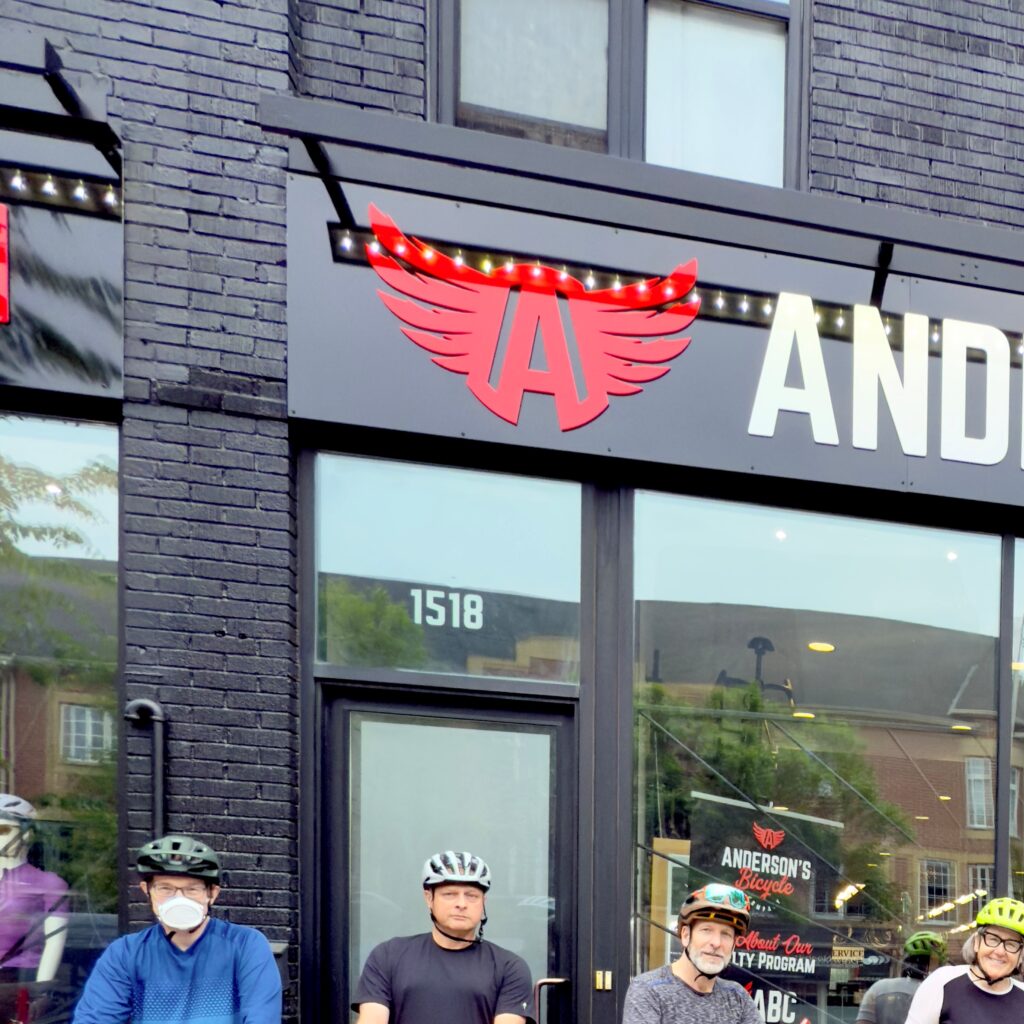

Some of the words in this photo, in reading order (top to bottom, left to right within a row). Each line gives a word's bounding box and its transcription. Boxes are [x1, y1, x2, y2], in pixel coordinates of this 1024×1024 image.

[410, 588, 484, 630] 1518
[721, 846, 812, 880] ANDERSON'S
[735, 867, 795, 900] Bicycle
[735, 931, 781, 952] About
[782, 934, 814, 955] Our
[832, 949, 864, 958] ERVICE
[732, 951, 756, 969] LTY
[757, 952, 817, 975] PROGRAM
[754, 989, 798, 1024] ABC
